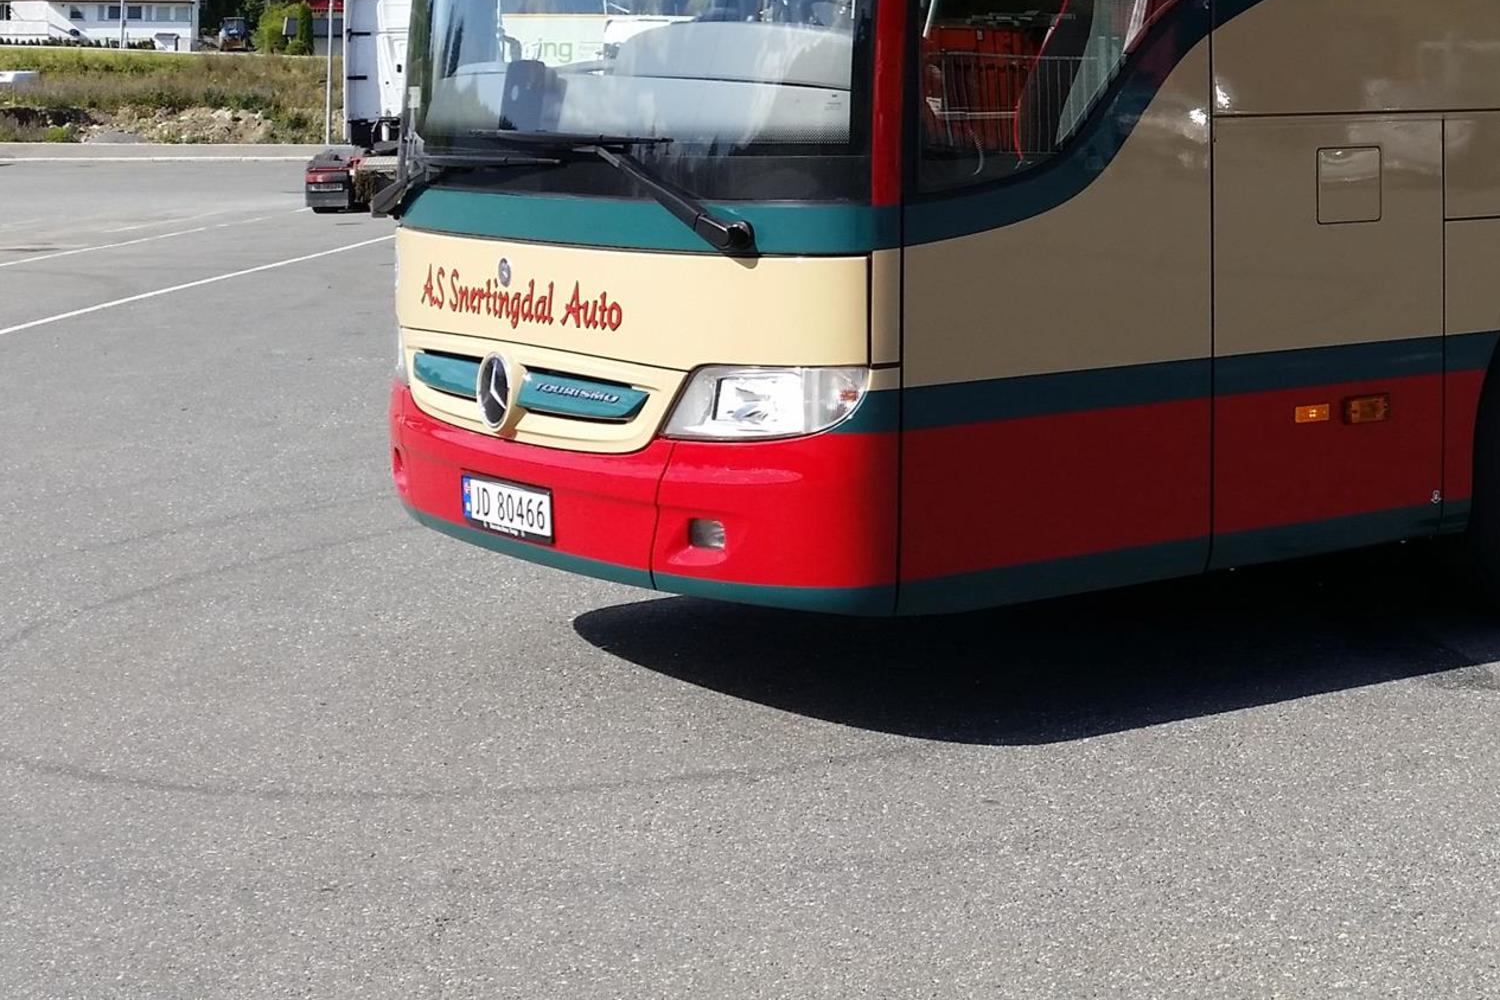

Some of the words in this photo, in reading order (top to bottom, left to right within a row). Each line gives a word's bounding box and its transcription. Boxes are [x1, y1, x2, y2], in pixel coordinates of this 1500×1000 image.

[449, 268, 554, 330] Snertingdal
[560, 280, 623, 332] Auto
[476, 486, 491, 517] JD
[497, 490, 546, 530] 80466
